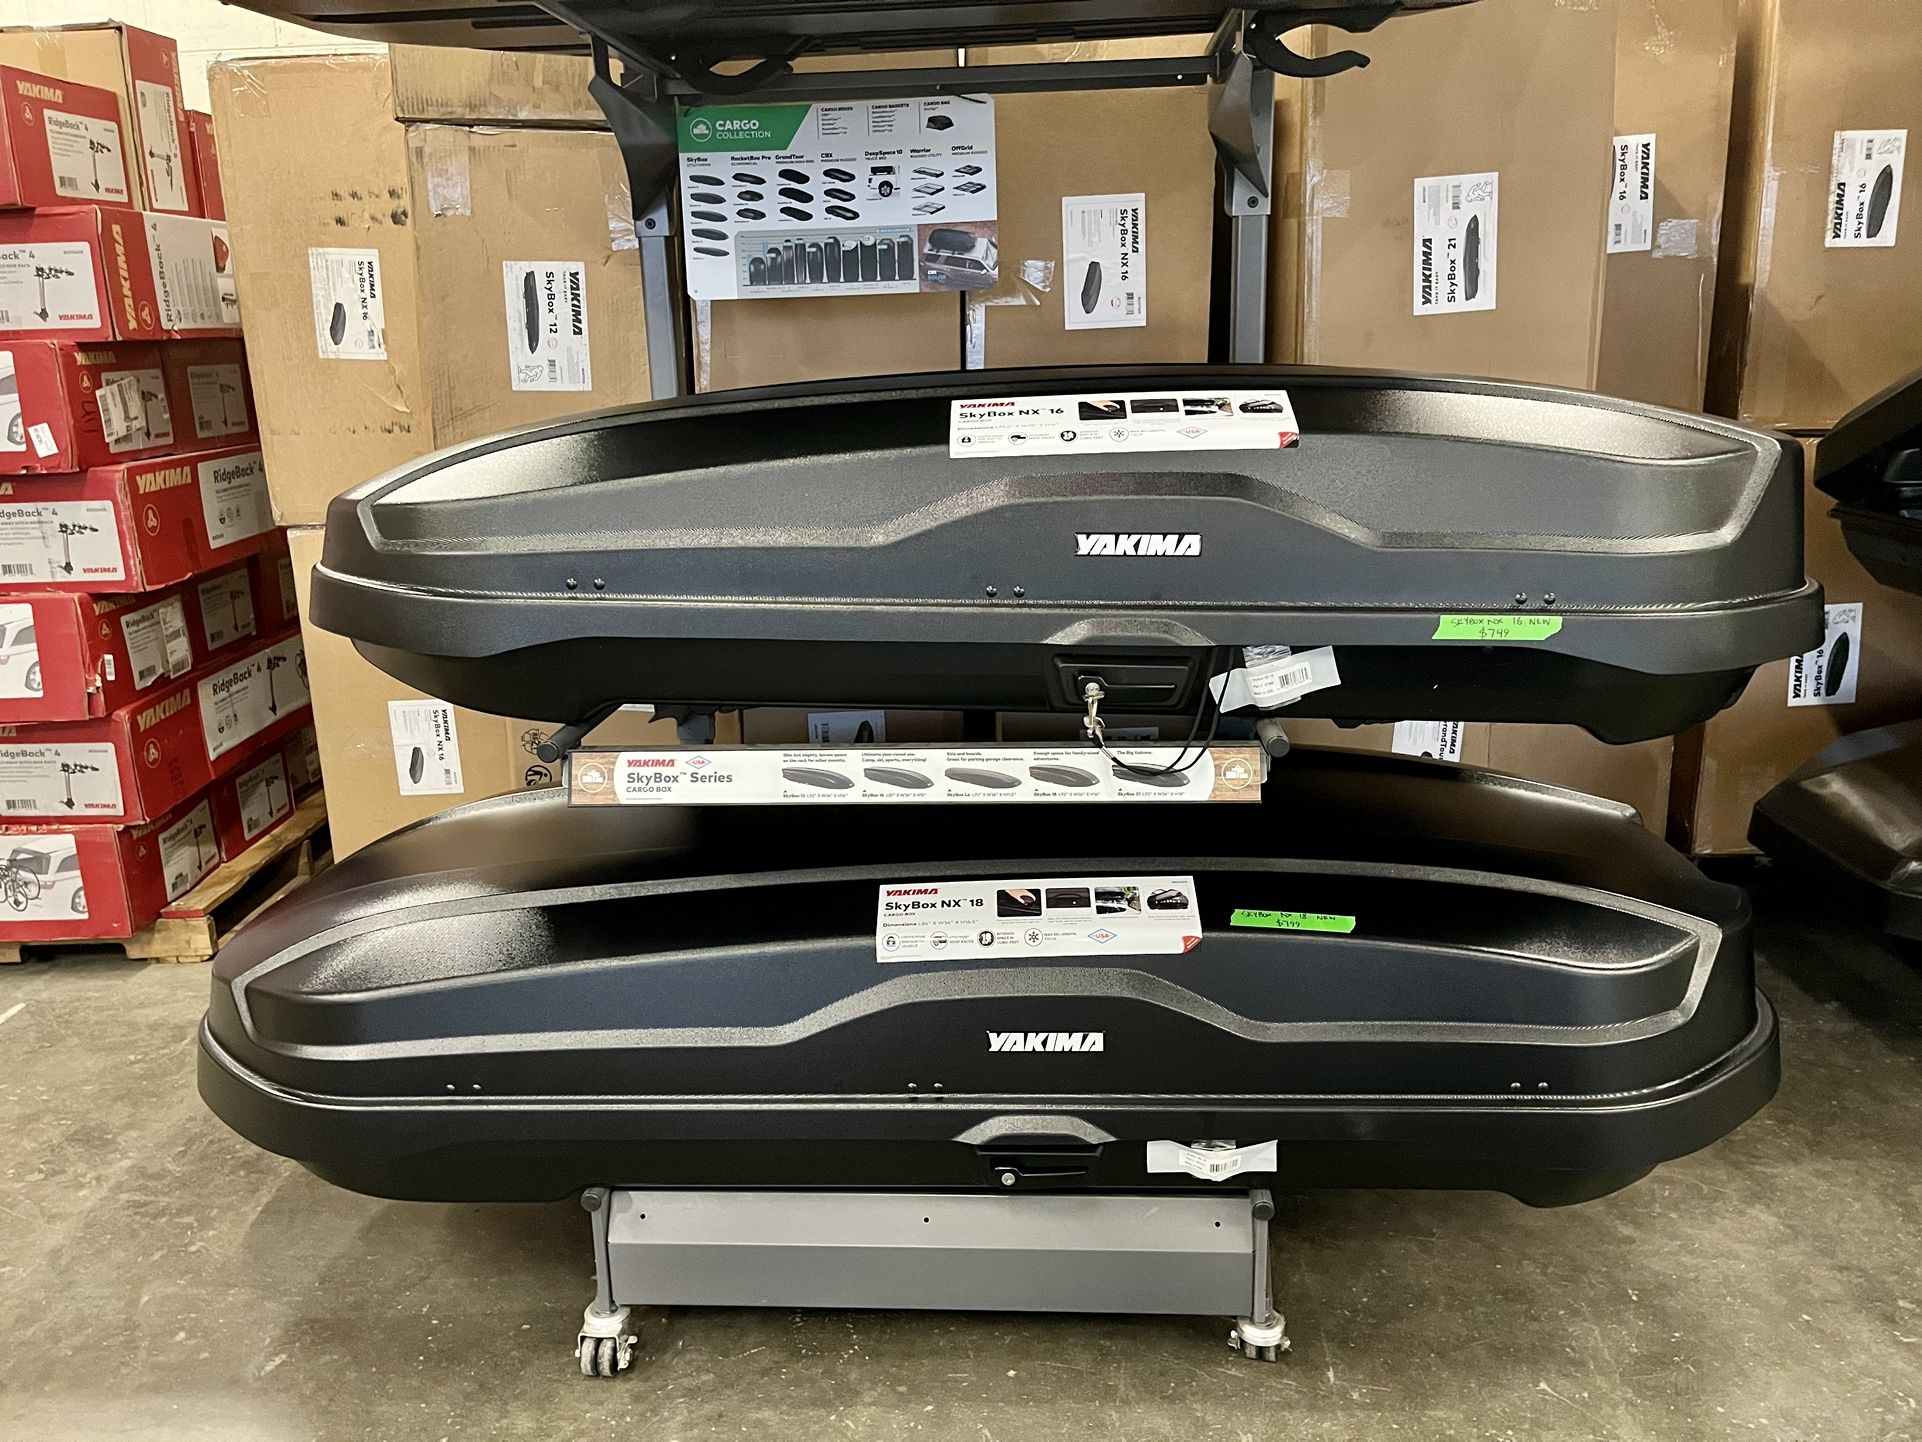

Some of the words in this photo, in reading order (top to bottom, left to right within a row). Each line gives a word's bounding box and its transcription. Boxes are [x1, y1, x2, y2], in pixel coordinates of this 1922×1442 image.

[16, 80, 63, 103] YAKIMA
[716, 120, 759, 130] CARGO
[716, 131, 771, 139] COLLECTION
[1640, 142, 1650, 200] YAKIMA
[1618, 190, 1626, 200] 16
[1859, 183, 1866, 194] 16
[1832, 182, 1846, 240] YAKIMA
[152, 222, 158, 232] 4
[1119, 208, 1129, 248] SkyBox
[1131, 208, 1139, 254] YAKIMA
[1448, 238, 1456, 250] 21
[29, 250, 36, 260] 4
[1120, 252, 1128, 268] NX
[112, 224, 138, 330] YAKIMA
[358, 260, 366, 294] SkyBox
[368, 260, 376, 298] YAKIMA
[1120, 270, 1129, 281] 16
[1422, 238, 1432, 306] YAKIMA
[361, 297, 368, 310] NX
[570, 272, 583, 336] YAKIMA
[548, 322, 558, 334] 12
[74, 352, 116, 366] YAKIMA
[960, 411, 1014, 420] SkyBox
[136, 466, 192, 494] YAKIMA
[52, 508, 58, 516] 4
[1076, 533, 1202, 556] YAKIMA
[1512, 616, 1523, 626] 16
[1480, 626, 1510, 638] $749
[1816, 649, 1824, 658] 16
[1792, 655, 1804, 699] YAKIM
[136, 688, 192, 733] YAKIMA
[432, 710, 440, 738] SkyBox
[437, 740, 444, 752] NX
[442, 709, 451, 742] YAKIMA
[1449, 721, 1458, 754] AKIMA
[627, 759, 676, 768] YAKIMA
[690, 771, 732, 783] Series
[886, 888, 940, 896] YAKIMA
[886, 900, 937, 912] SkyBox
[970, 898, 984, 907] 18
[988, 1032, 1105, 1052] YAKIMA
